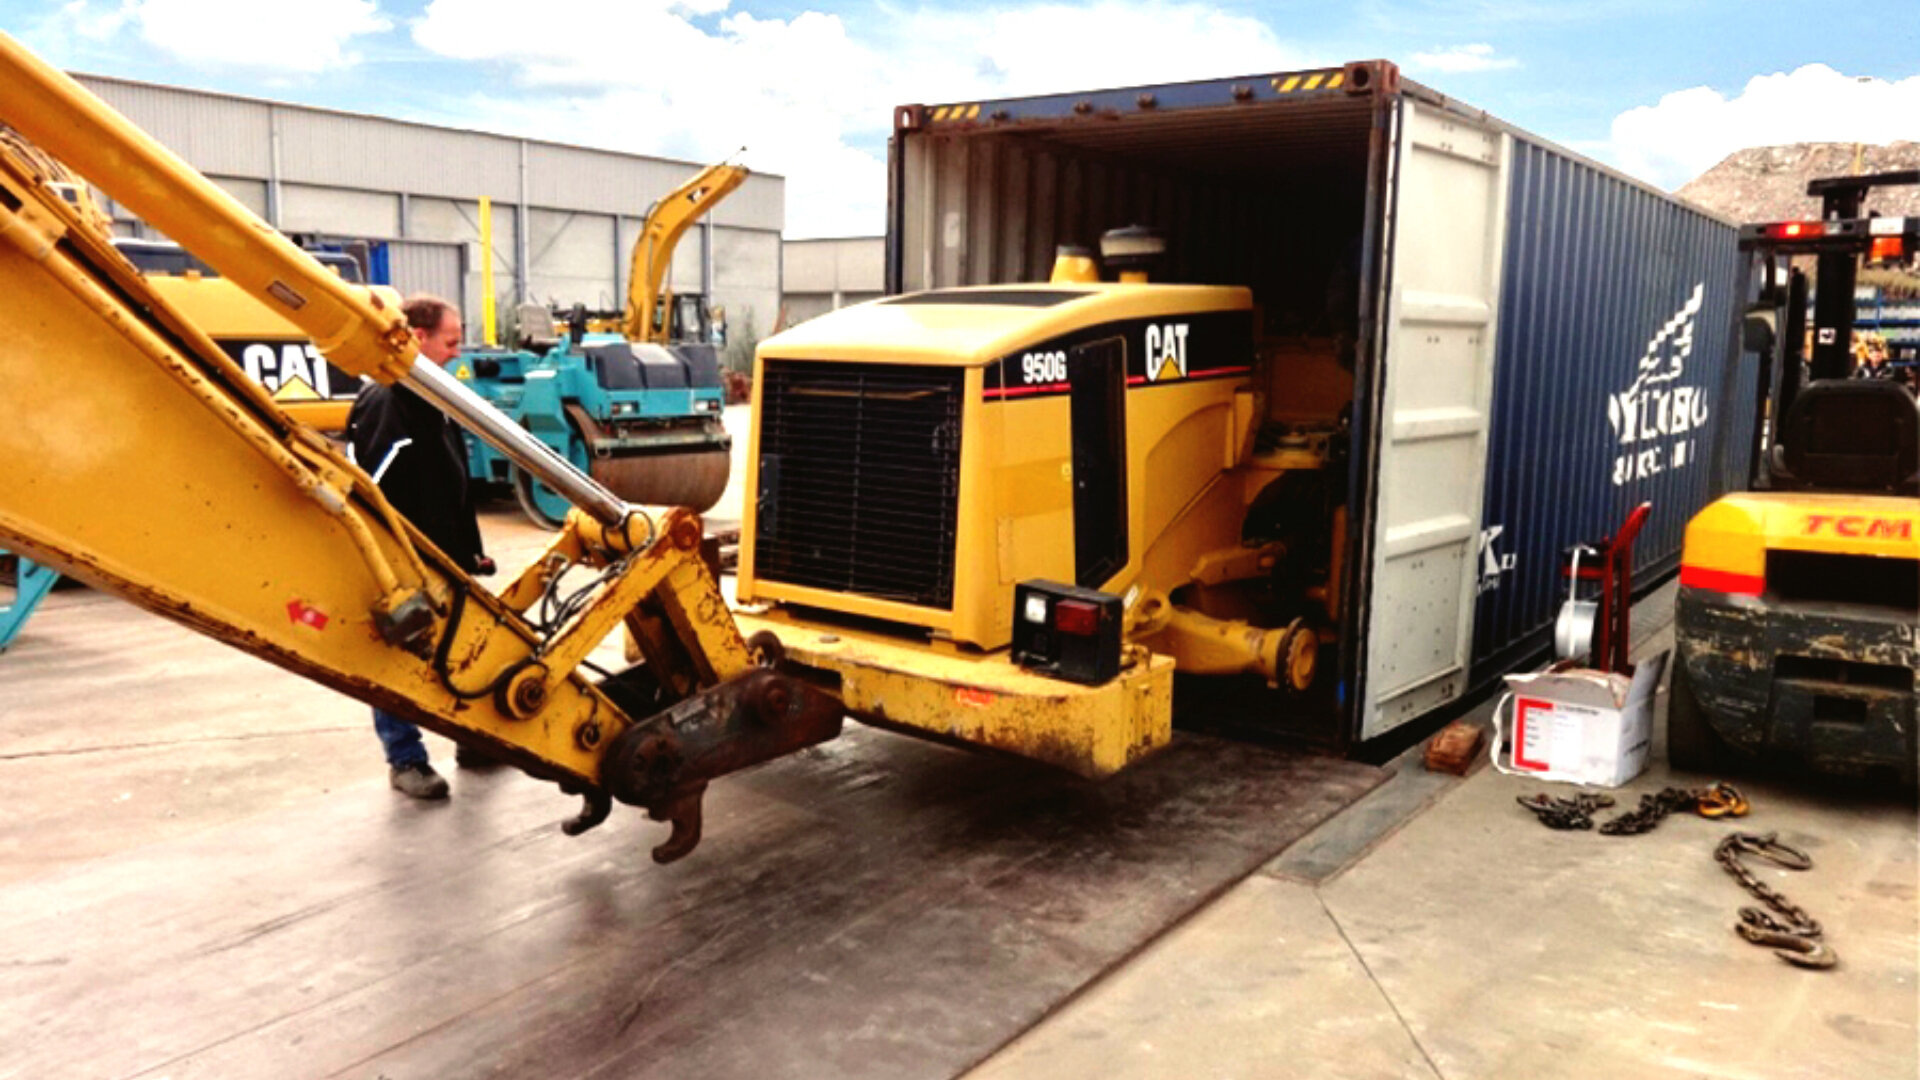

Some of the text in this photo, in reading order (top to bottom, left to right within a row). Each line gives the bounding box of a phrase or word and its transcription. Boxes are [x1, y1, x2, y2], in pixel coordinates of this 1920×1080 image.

[242, 344, 331, 400] CAT
[1022, 351, 1067, 383] 950G
[1145, 323, 1189, 381] CAT
[1805, 514, 1912, 540] TCM
